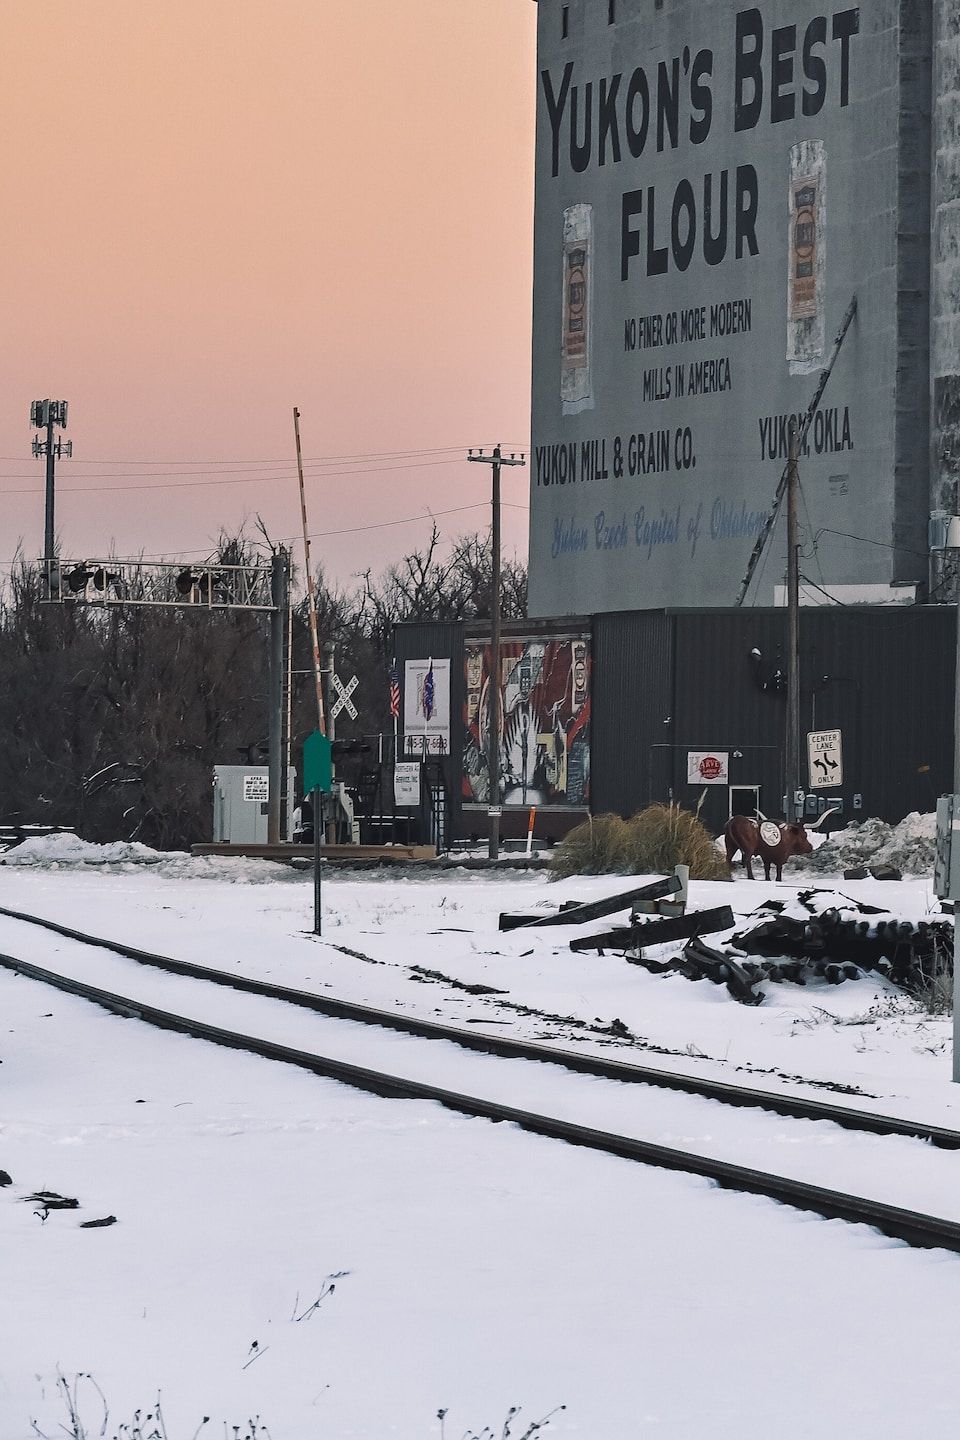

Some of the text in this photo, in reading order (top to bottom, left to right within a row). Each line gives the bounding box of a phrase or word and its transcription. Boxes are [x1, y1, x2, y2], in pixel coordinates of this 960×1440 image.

[541, 7, 860, 178] YUKON'S BEST
[621, 163, 760, 282] FLOUR
[624, 298, 752, 352] NO FINER OR MORE MODERN
[643, 357, 732, 402] MILLS IN AMERICA
[814, 406, 854, 455] OKLA.
[536, 426, 697, 487] YUKON MILL & GRAIN CO.
[812, 734, 837, 743] CENTER
[816, 742, 834, 750] LANE
[817, 775, 835, 784] ONLY
